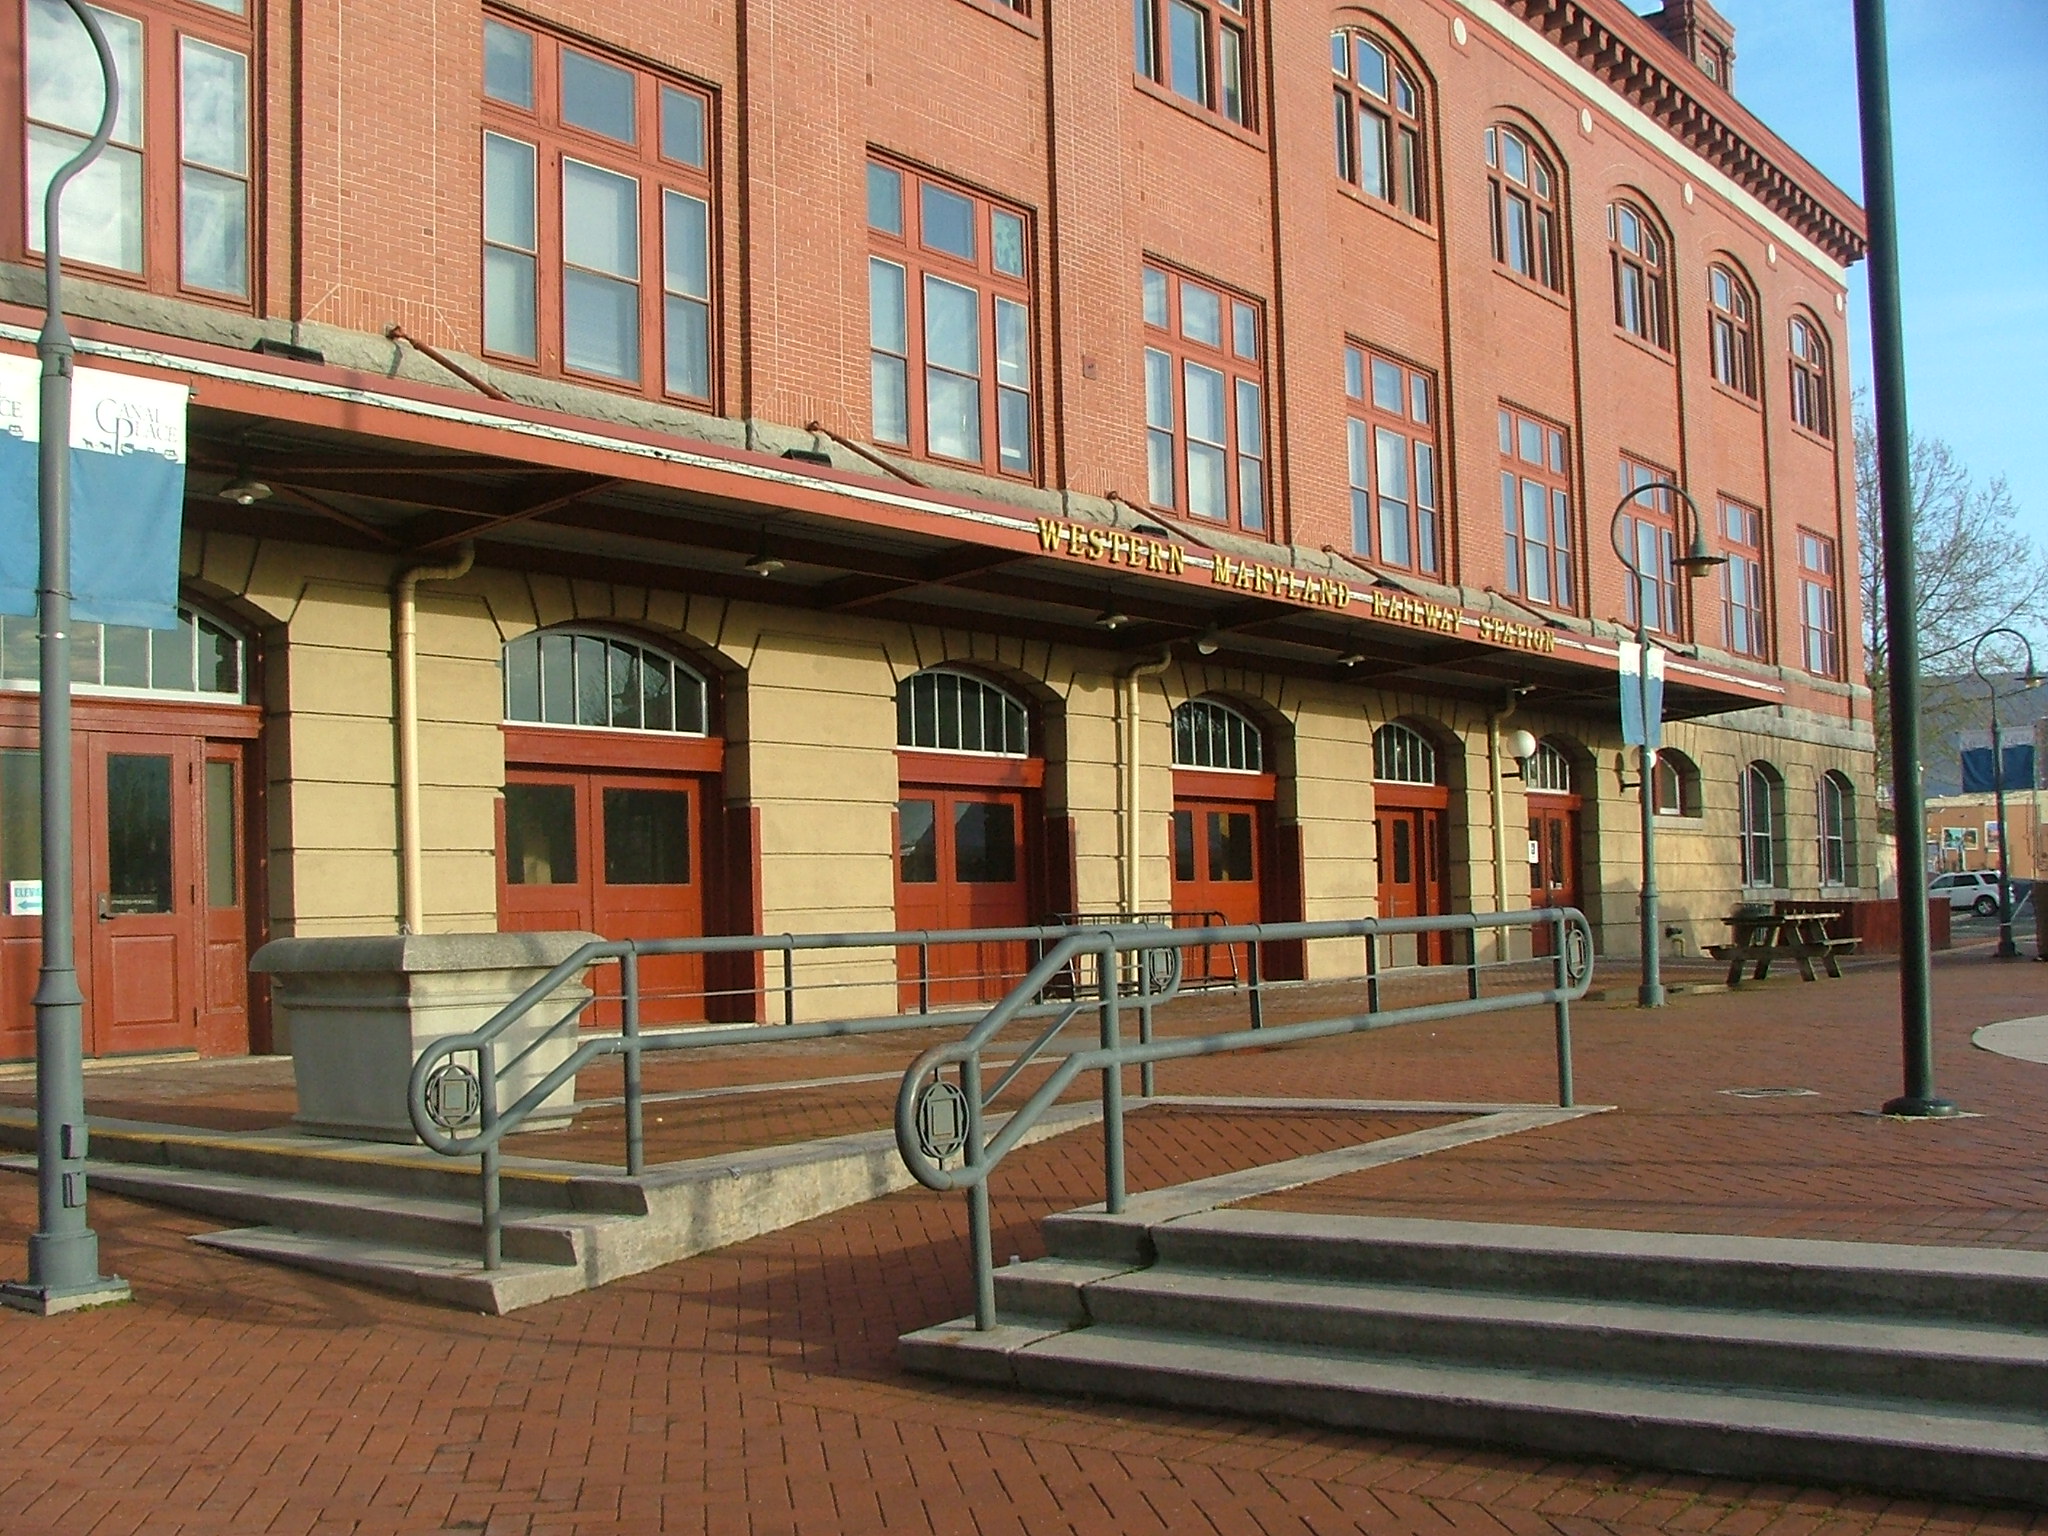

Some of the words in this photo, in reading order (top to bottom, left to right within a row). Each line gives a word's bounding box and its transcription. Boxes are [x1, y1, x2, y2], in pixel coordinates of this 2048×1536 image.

[1037, 516, 1186, 575] WESTERN
[1211, 552, 1350, 608] MARYLAND
[1371, 589, 1464, 634] RAILWAY
[1477, 614, 1556, 653] STATION
